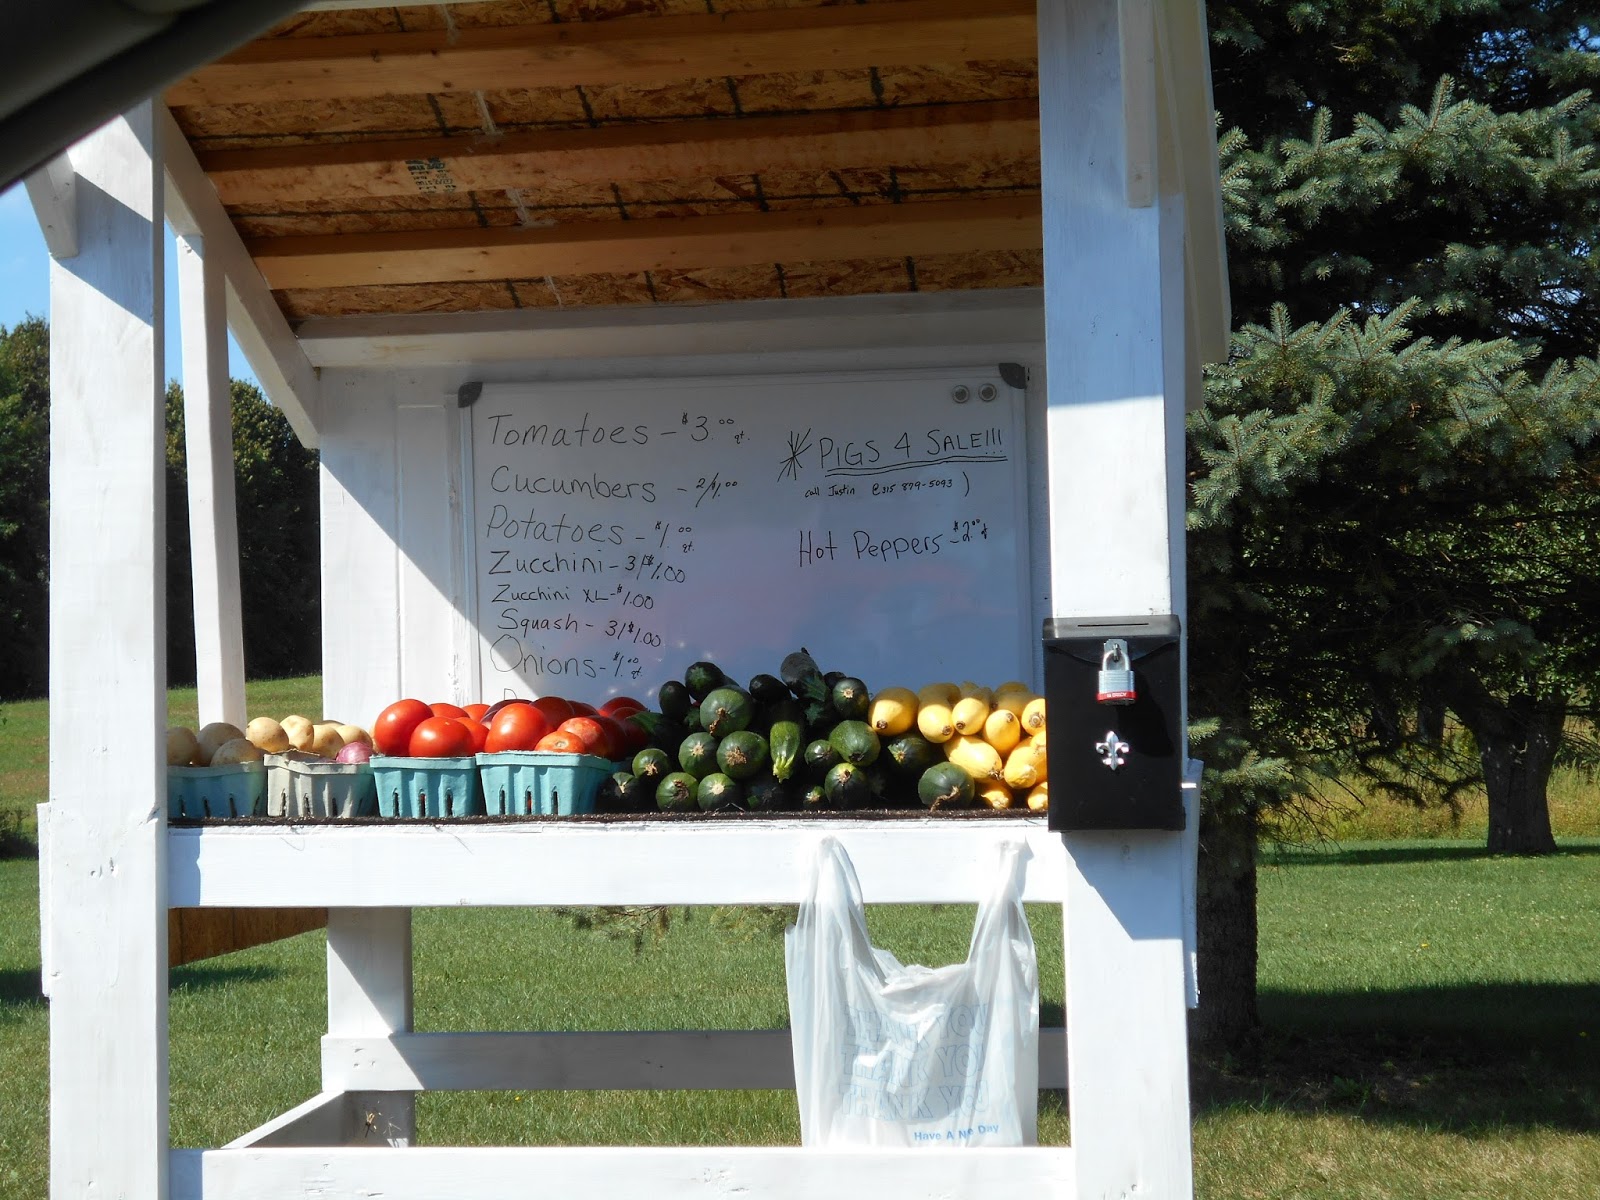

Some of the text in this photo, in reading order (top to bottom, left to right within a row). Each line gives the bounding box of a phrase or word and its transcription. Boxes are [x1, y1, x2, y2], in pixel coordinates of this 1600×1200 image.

[488, 412, 649, 447] Tomatoes
[819, 428, 1002, 469] PIGS 4 SALE!!!
[490, 465, 656, 503] Cucumbers
[804, 486, 820, 498] call
[828, 486, 855, 497] Justin
[486, 504, 624, 545] Potatoes
[488, 549, 603, 576] Zucchini
[800, 530, 838, 567] Hot
[853, 530, 944, 562] Peppers
[491, 583, 570, 603] Zucchini
[497, 608, 578, 638] Squash
[490, 633, 597, 678] Onions
[839, 1082, 933, 1121] THANK
[914, 1131, 942, 1142] Have
[946, 1130, 955, 1141] A
[977, 1123, 999, 1136] Day
